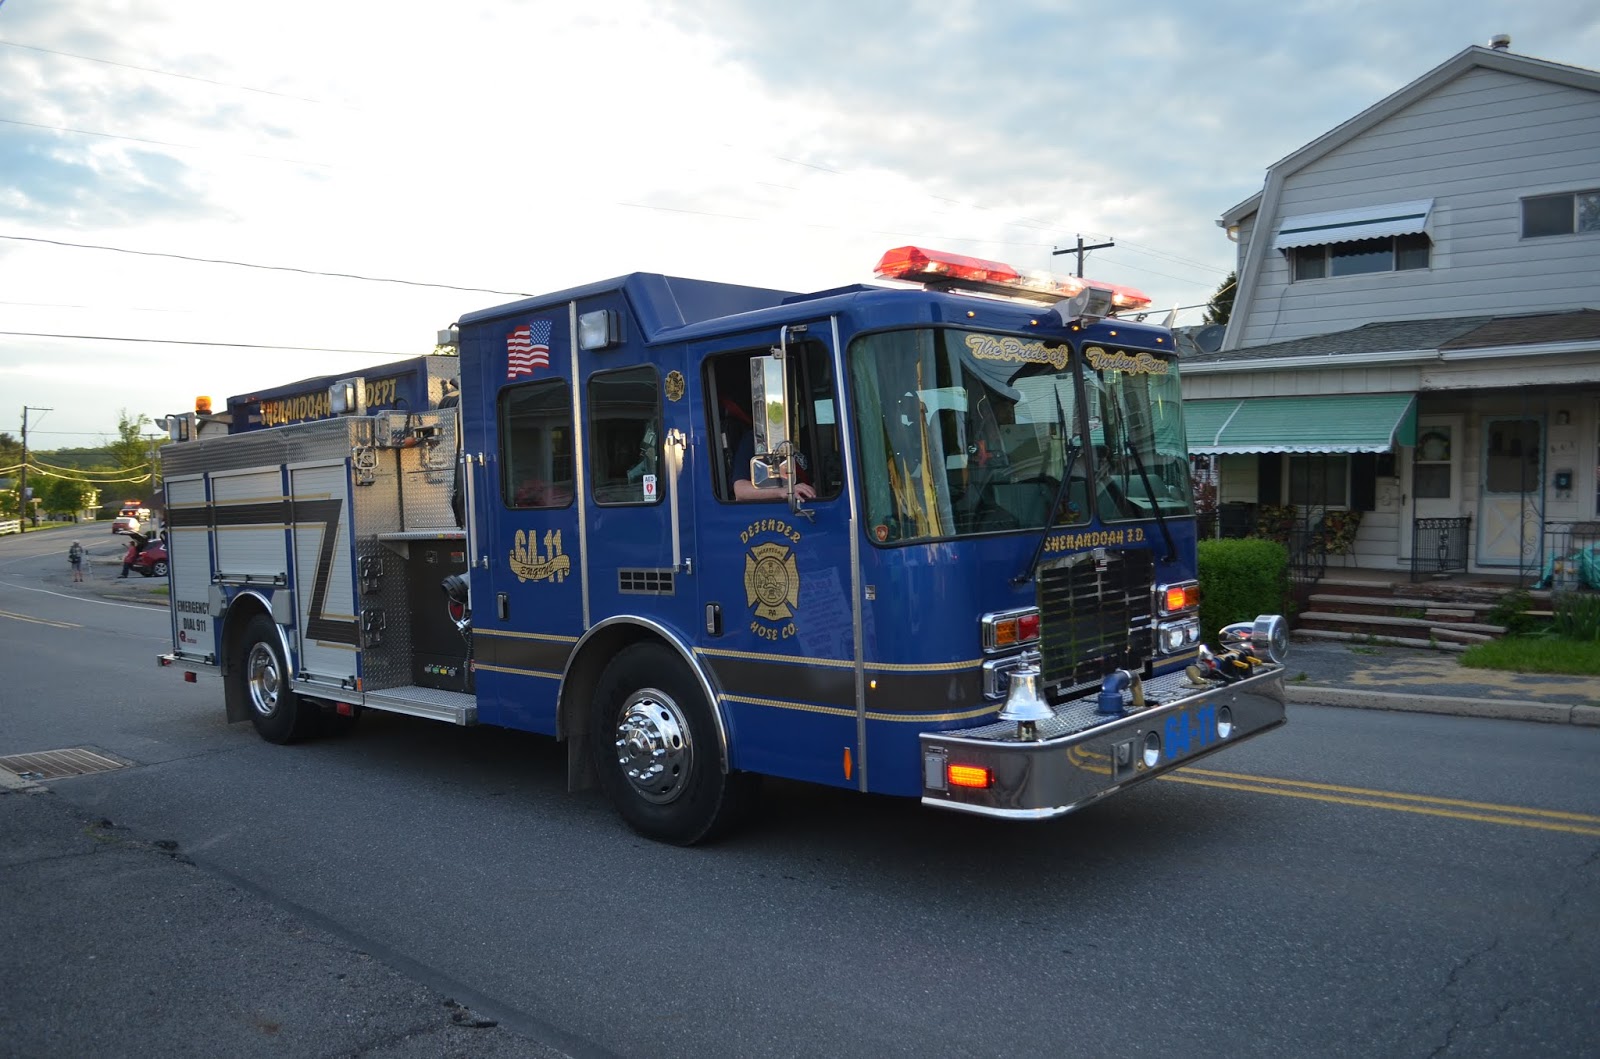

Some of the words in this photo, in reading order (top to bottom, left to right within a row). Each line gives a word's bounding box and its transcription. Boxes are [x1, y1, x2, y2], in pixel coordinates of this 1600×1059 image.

[969, 337, 1001, 356] The
[1003, 340, 1048, 361] Pride
[1050, 346, 1064, 365] of
[1088, 350, 1137, 372] Turkey
[1139, 354, 1168, 373] Run
[260, 391, 331, 427] SHENANDOAH
[365, 379, 397, 408] DEPT
[740, 519, 801, 544] DEFENDER
[1044, 529, 1124, 553] SHENANDOAH
[520, 561, 555, 578] ENGINE
[177, 600, 210, 614] EMERGENCY
[183, 617, 196, 630] DIAL
[196, 619, 206, 632] 911
[750, 621, 778, 640] HOSE
